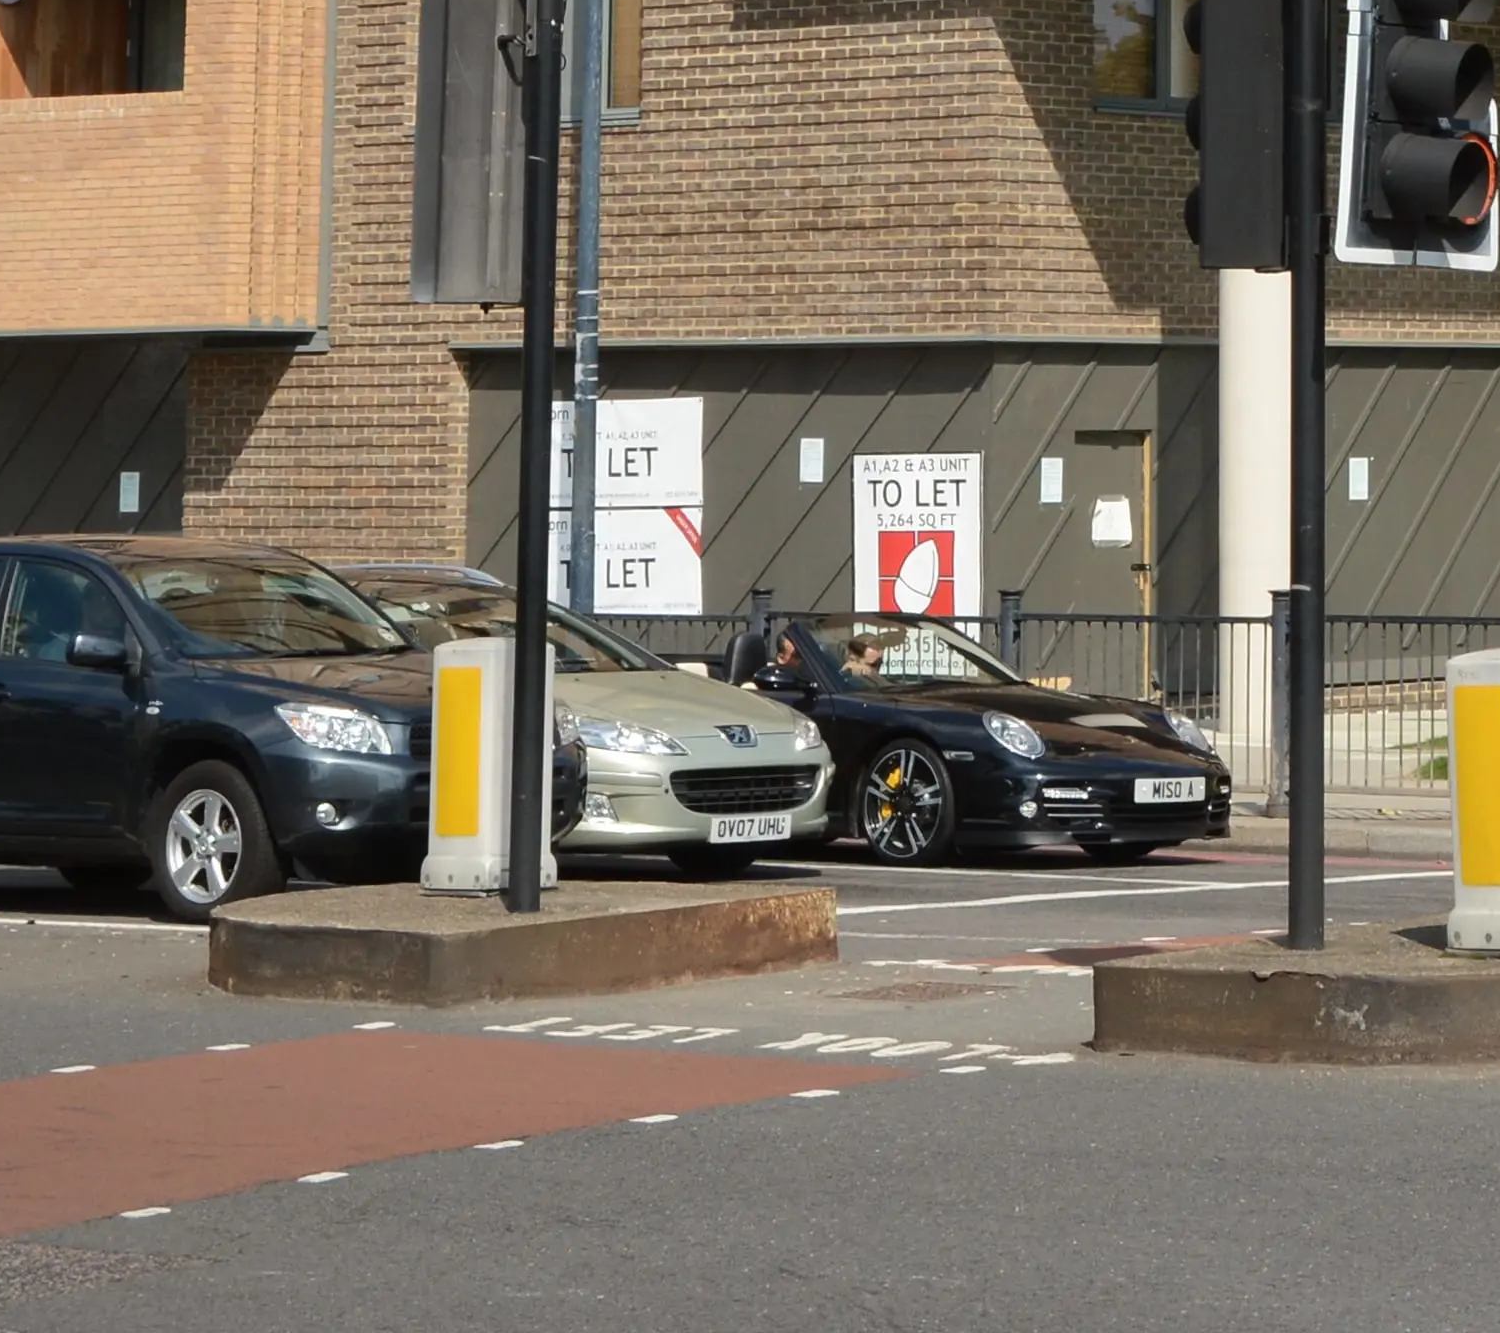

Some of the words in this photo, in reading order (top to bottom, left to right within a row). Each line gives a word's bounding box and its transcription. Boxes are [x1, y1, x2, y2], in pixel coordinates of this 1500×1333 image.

[608, 446, 659, 477] LET
[904, 459, 914, 472] &
[918, 459, 935, 472] A3
[940, 458, 971, 471] UNIT
[867, 479, 902, 507] TO
[916, 478, 967, 507] LET
[877, 514, 914, 529] 5,264
[918, 513, 937, 529] SQ
[940, 513, 957, 526] FT
[606, 557, 656, 588] LET
